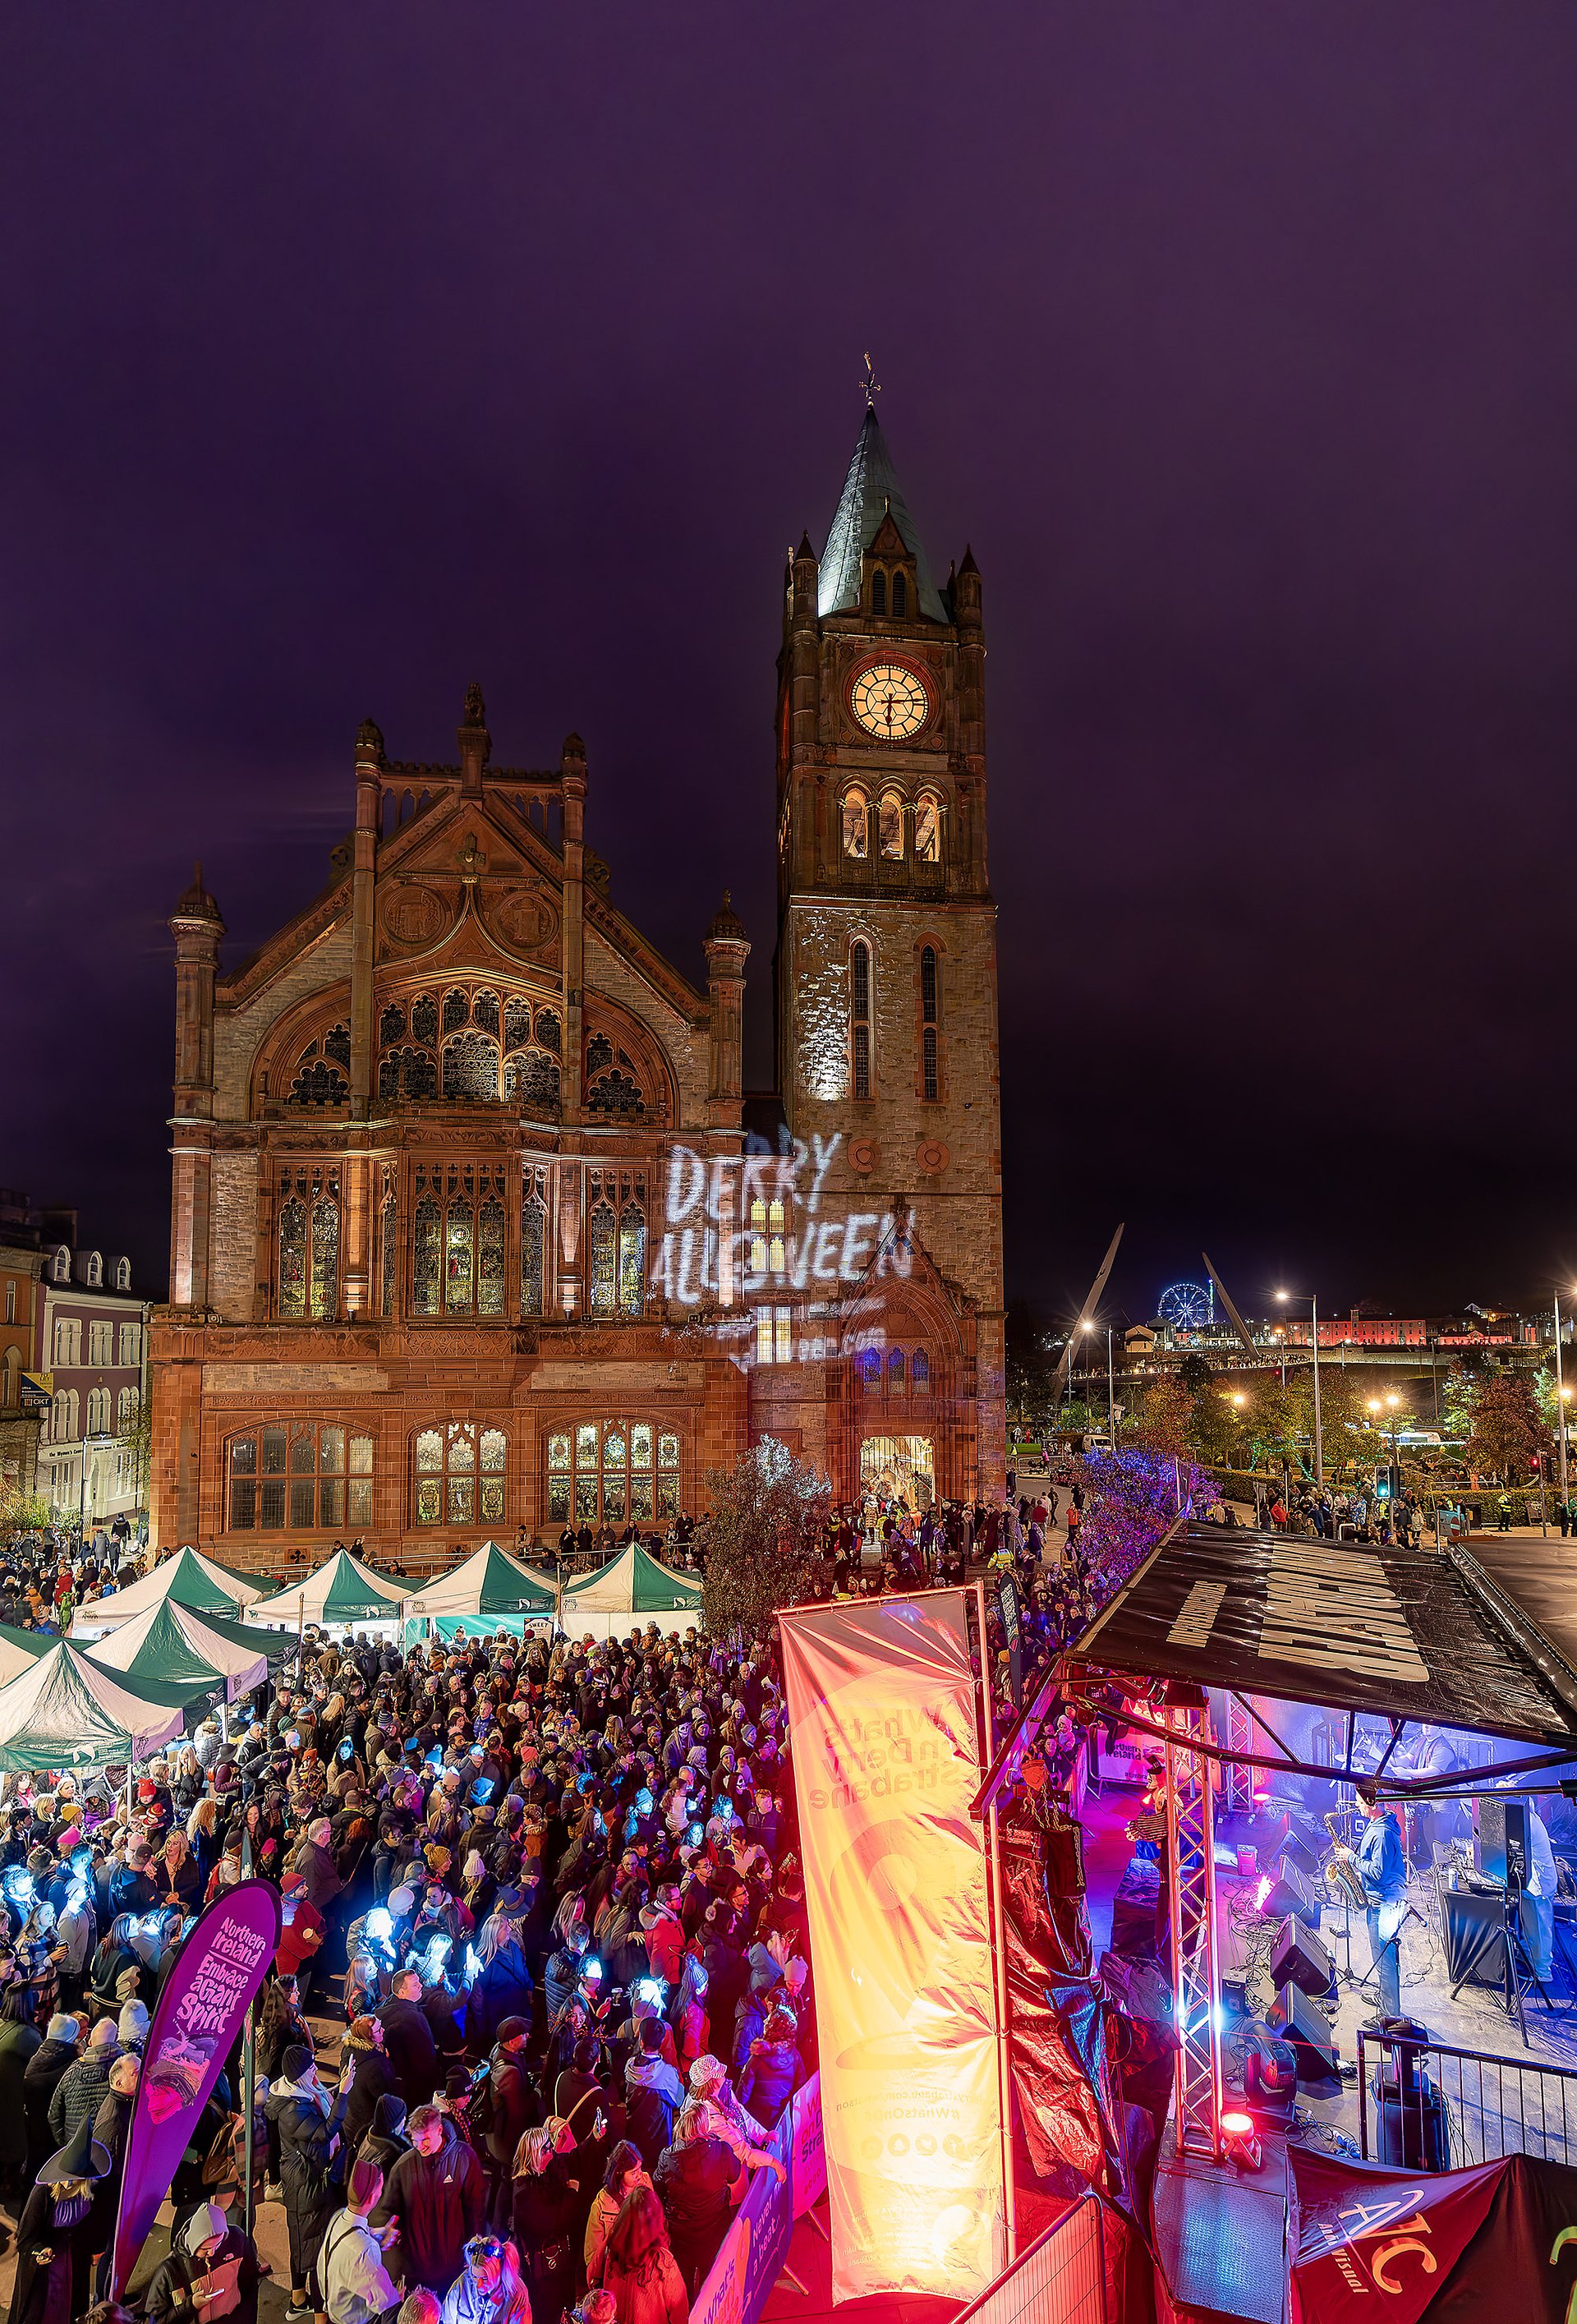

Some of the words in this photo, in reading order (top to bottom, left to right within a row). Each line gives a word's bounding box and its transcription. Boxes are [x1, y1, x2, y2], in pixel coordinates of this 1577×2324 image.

[664, 1132, 843, 1224] DERRY
[1257, 1571, 1431, 1682] COASTER
[1114, 1742, 1141, 1753] rthern
[211, 1931, 263, 1968] Ireland
[220, 1917, 266, 1951] Northern
[197, 1954, 249, 1990] Embrace
[190, 1975, 202, 1992] a
[196, 1977, 241, 2012] Giant
[177, 1992, 232, 2034] Spirit
[802, 2128, 823, 2164] Stra
[752, 2193, 773, 2248] Never
[1331, 2248, 1369, 2294] Visual
